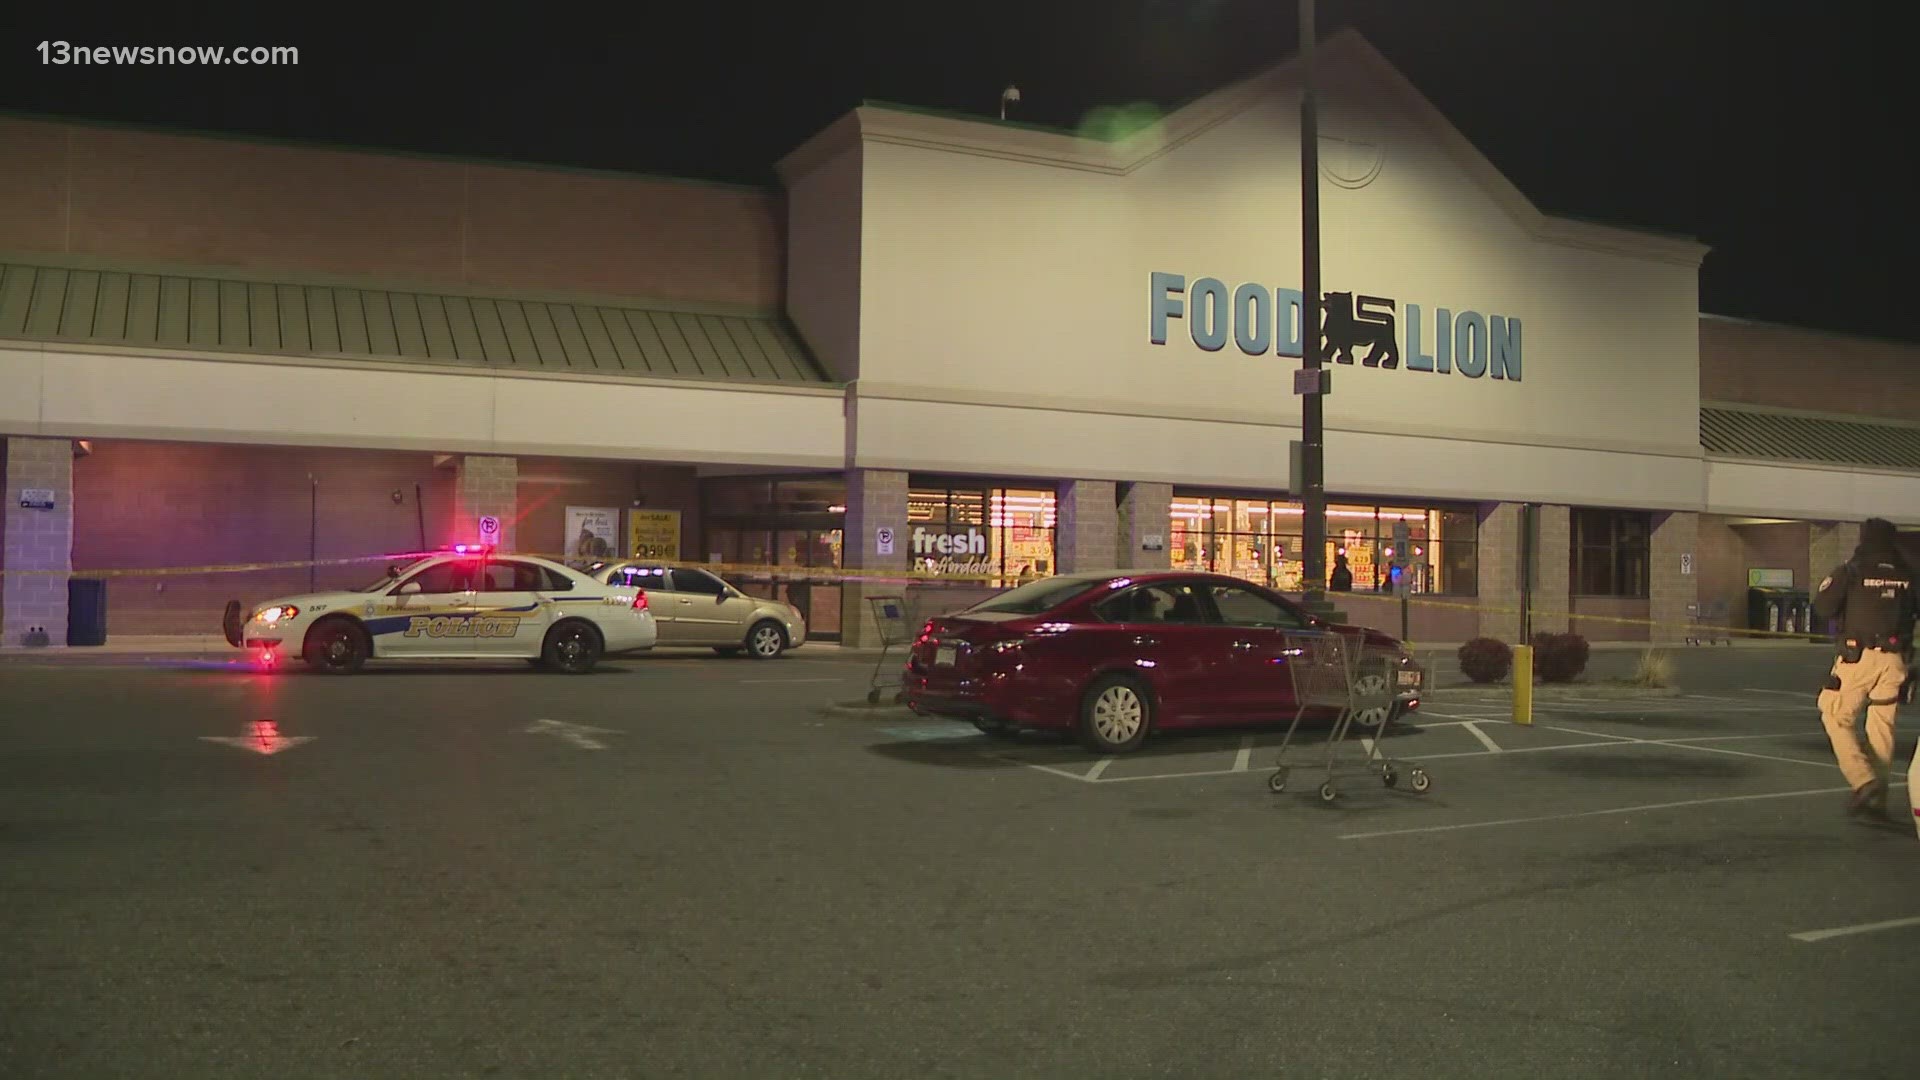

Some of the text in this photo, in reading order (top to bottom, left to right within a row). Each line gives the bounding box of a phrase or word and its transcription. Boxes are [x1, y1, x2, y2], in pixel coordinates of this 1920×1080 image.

[1148, 271, 1522, 382] FOOD LION
[912, 526, 986, 554] fresh
[1863, 579, 1909, 589] SECTY
[403, 616, 521, 638] POLICE
